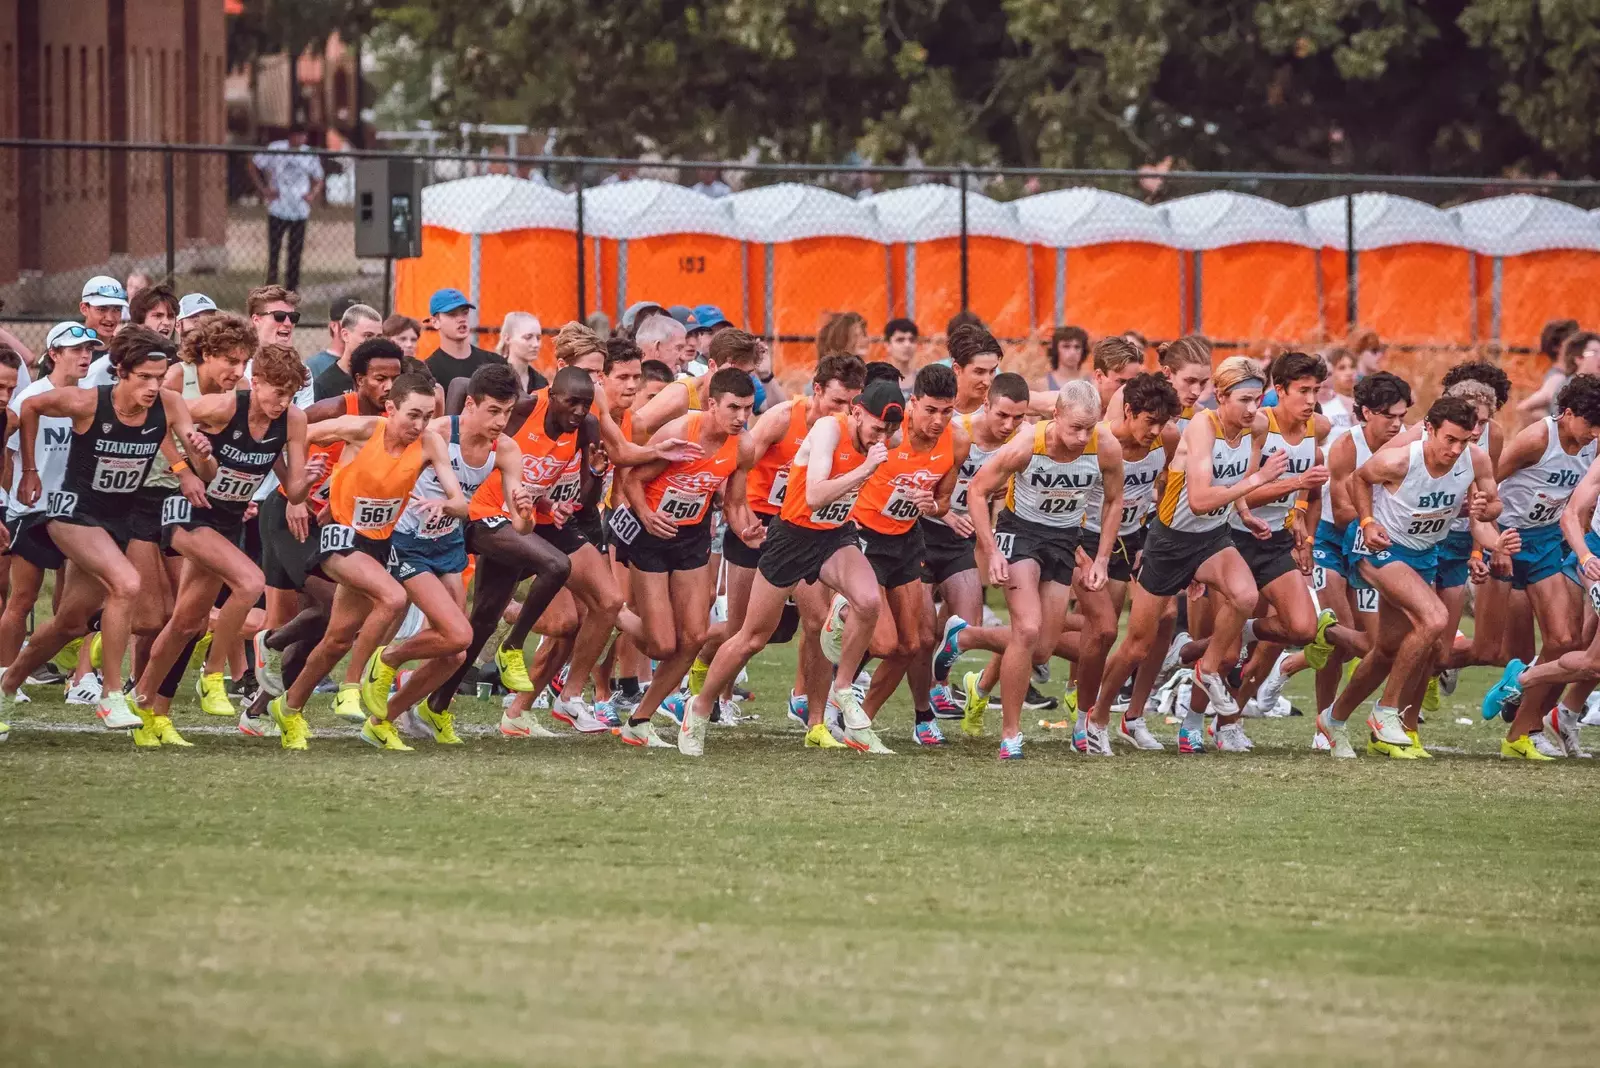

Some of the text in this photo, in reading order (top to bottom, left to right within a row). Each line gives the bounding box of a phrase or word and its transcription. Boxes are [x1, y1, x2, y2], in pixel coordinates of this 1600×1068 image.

[95, 439, 158, 455] STANFORD
[220, 444, 277, 466] STANFORD
[99, 469, 140, 489] 502
[217, 476, 254, 496] 510
[1032, 474, 1093, 488] NAU
[1124, 470, 1158, 486] AU
[1547, 469, 1579, 487] BYU
[1038, 498, 1078, 514] 424
[1417, 491, 1456, 508] BYU
[163, 498, 189, 522] 510
[360, 507, 393, 523] 561
[662, 499, 701, 519] 450
[612, 508, 637, 541] 450
[1407, 518, 1446, 535] 320
[322, 526, 350, 549] 561
